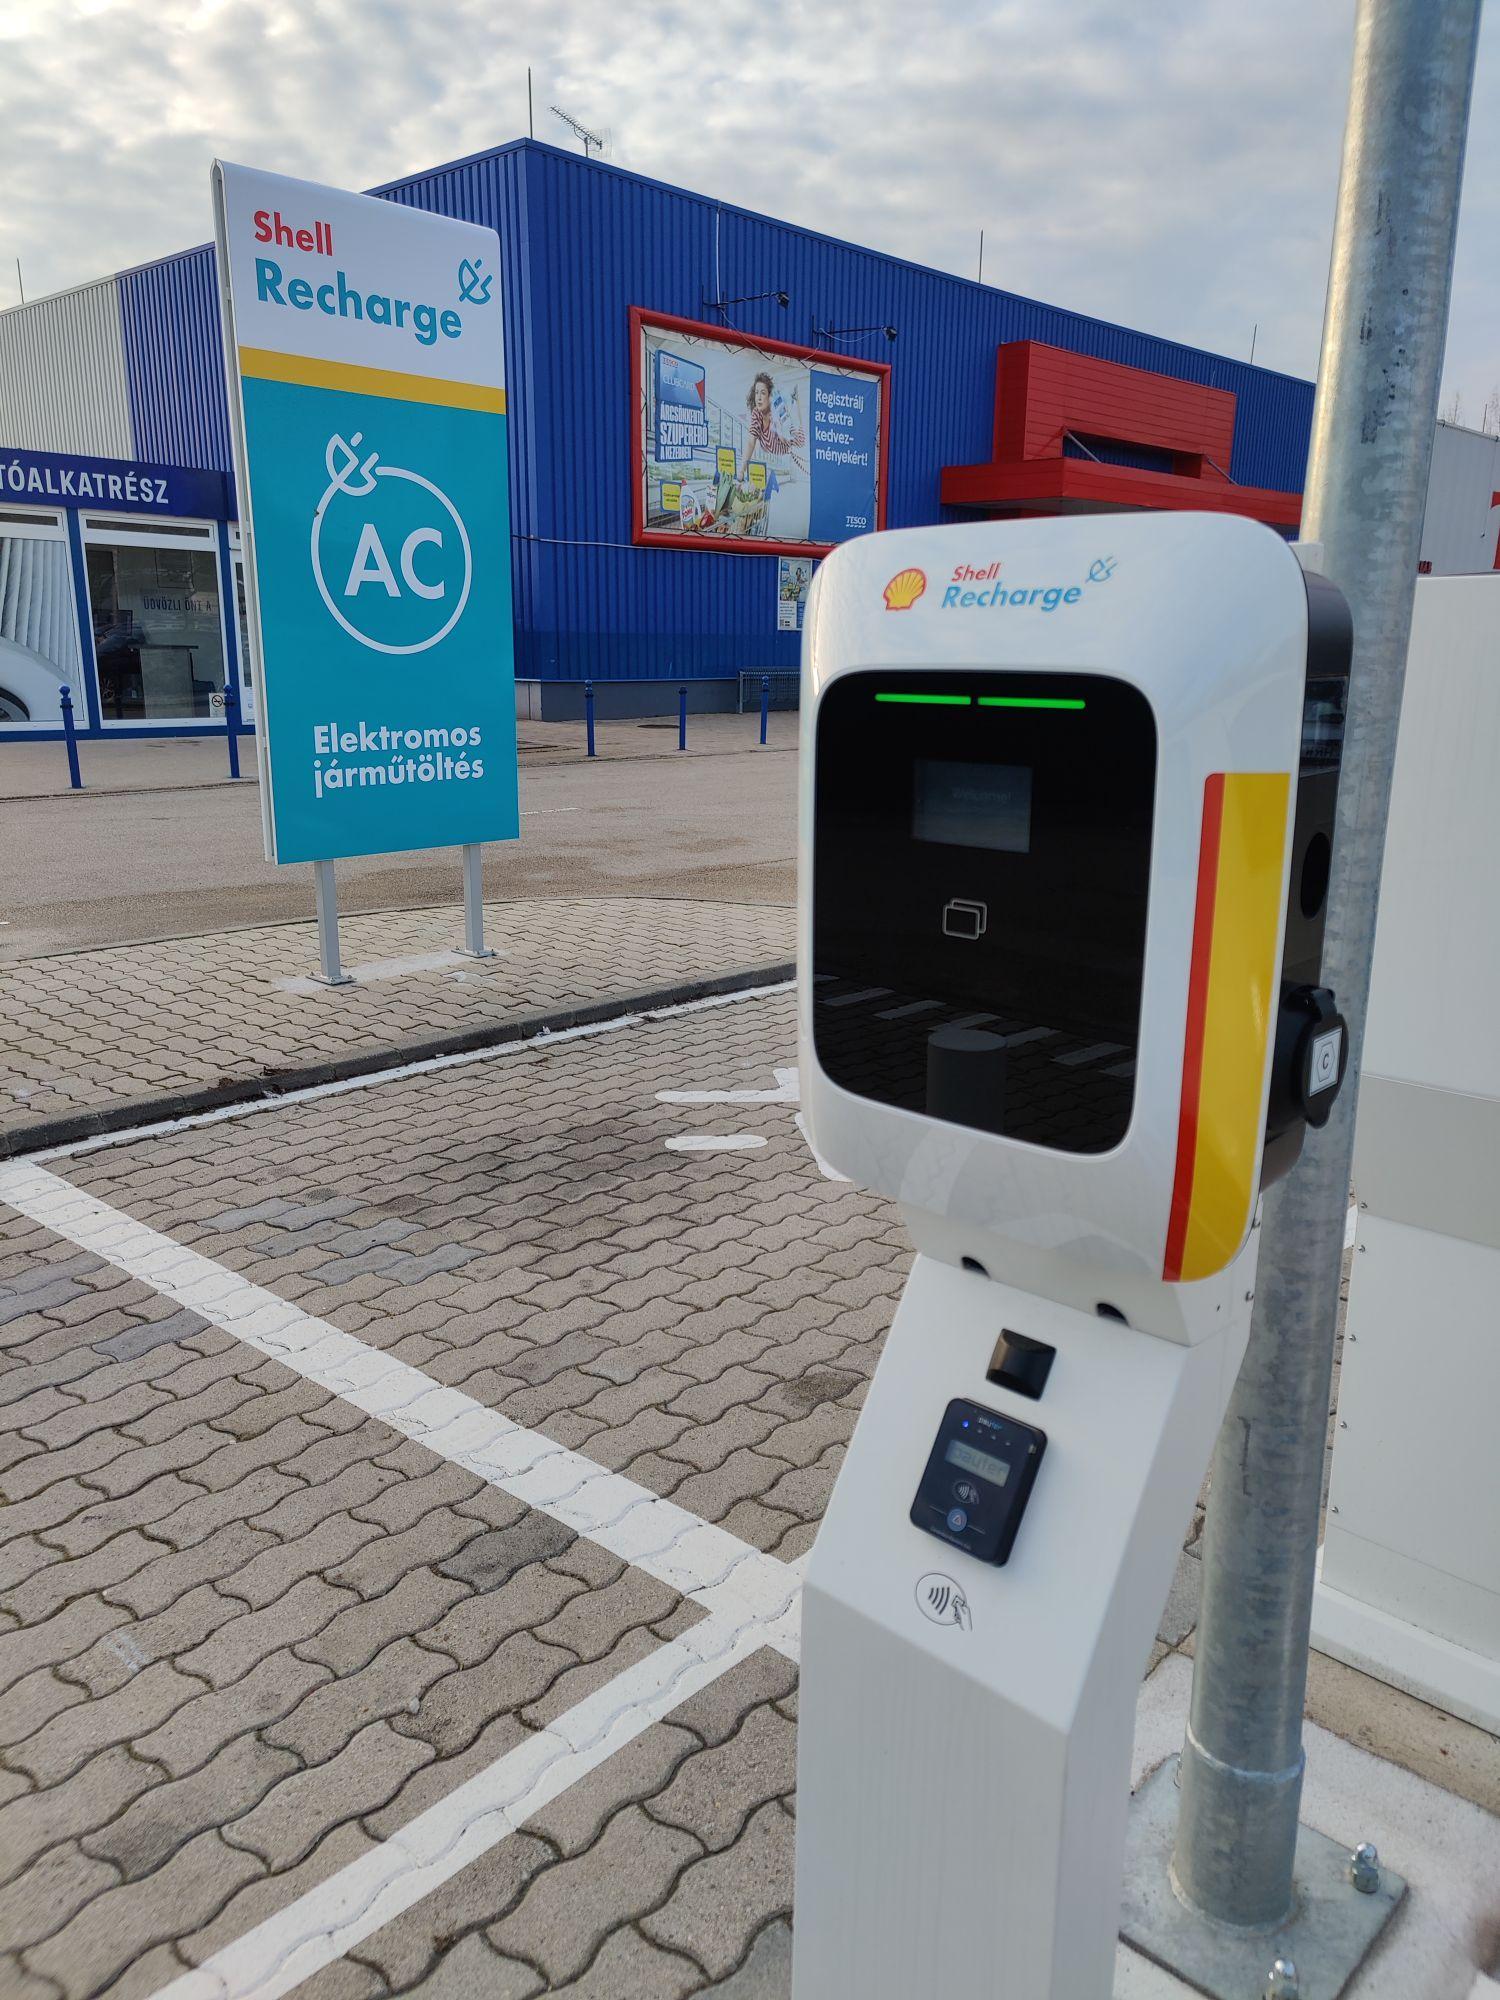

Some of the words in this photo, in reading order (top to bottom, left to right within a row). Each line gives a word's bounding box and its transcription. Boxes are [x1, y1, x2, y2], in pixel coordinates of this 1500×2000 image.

[253, 210, 333, 257] Shell
[254, 257, 462, 346] Recharge
[815, 388, 865, 414] Regisztrálj
[815, 411, 826, 423] az
[828, 413, 854, 427] extra
[815, 427, 854, 445] kedvez-
[816, 447, 868, 467] ményekért!
[846, 515, 867, 527] TESCO
[344, 523, 445, 600] AC
[952, 562, 1002, 582] Shell
[941, 582, 1082, 612] Recharge
[314, 721, 482, 754] Elektromos
[313, 751, 484, 799] járműtöltés
[1322, 1052, 1329, 1070] C
